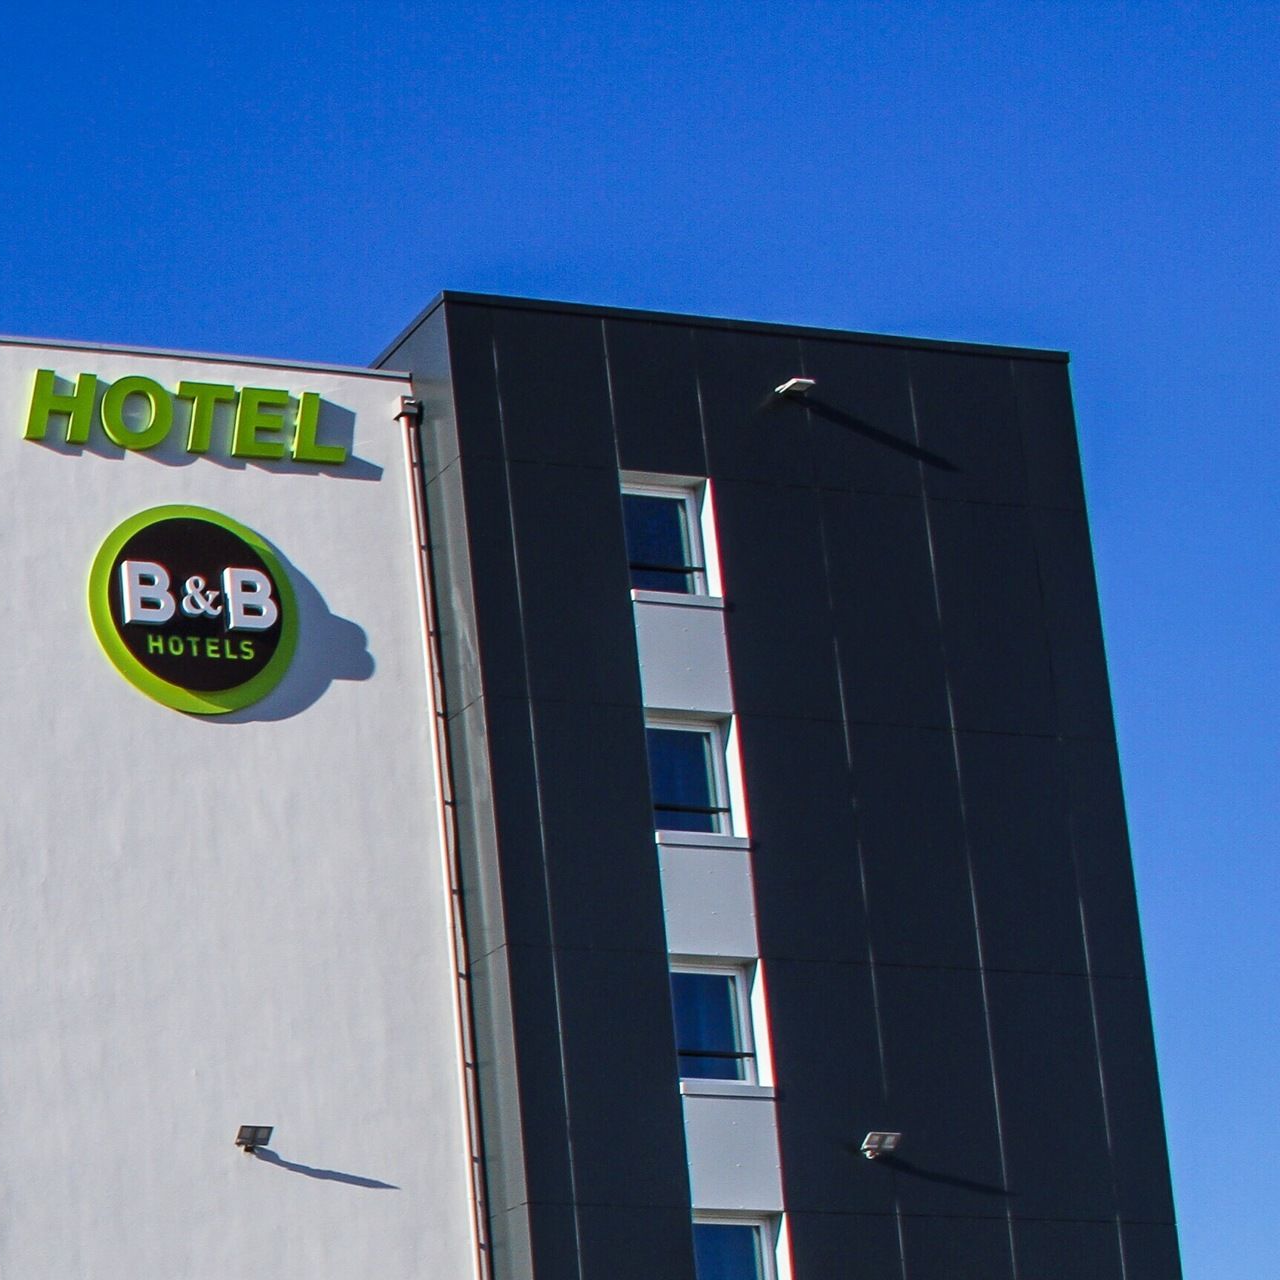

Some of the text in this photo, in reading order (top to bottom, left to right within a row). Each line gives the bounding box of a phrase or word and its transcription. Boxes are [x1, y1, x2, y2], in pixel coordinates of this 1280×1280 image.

[23, 368, 349, 465] HOTEL
[121, 560, 279, 632] B&B
[146, 632, 256, 661] HOTELS
